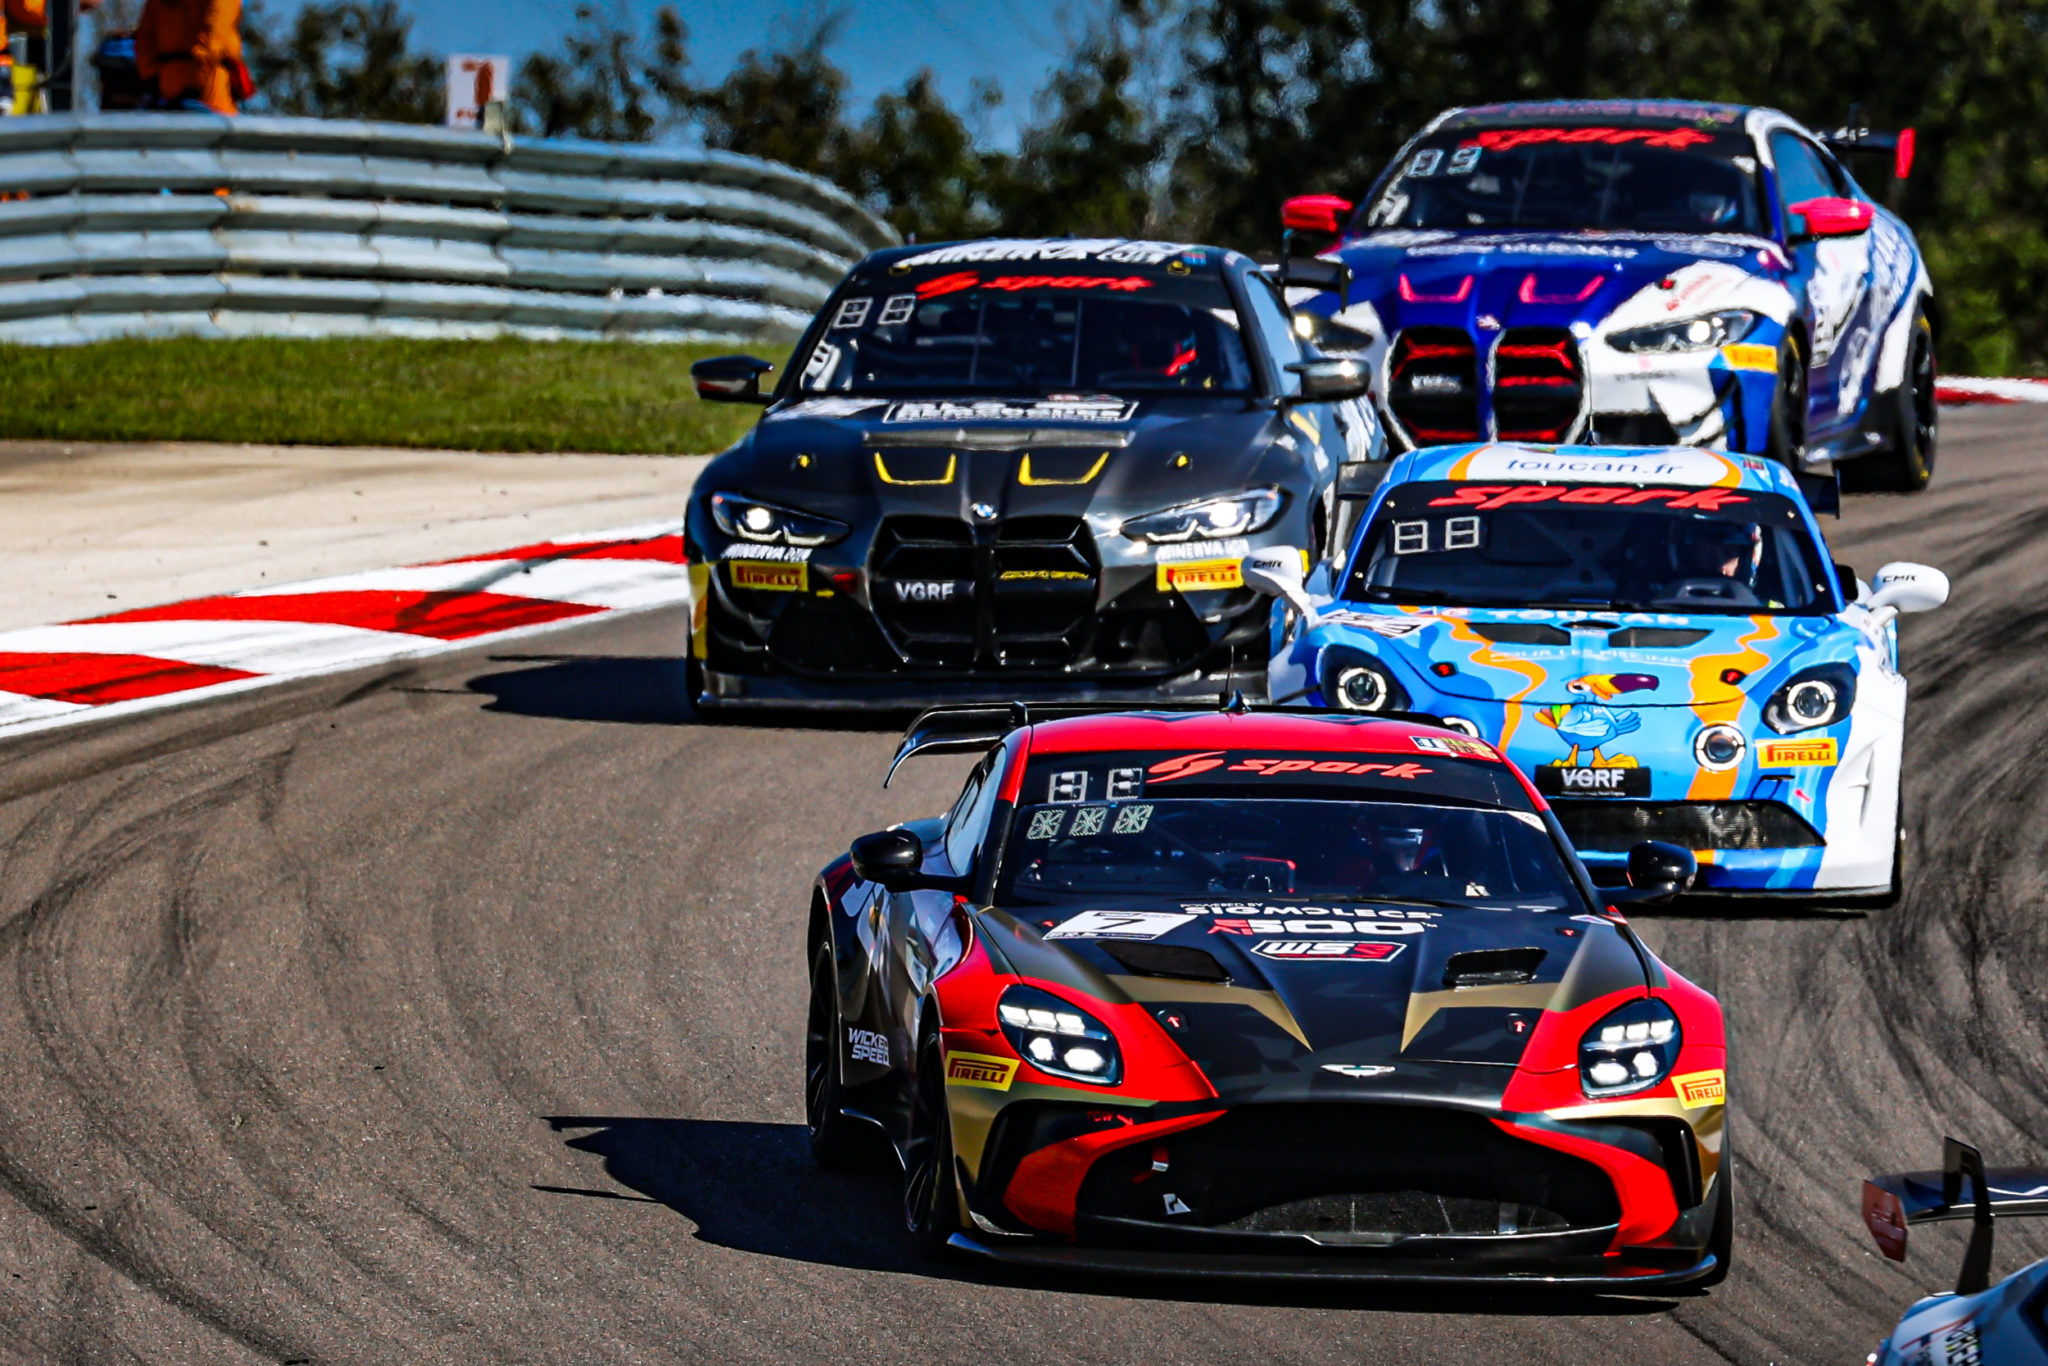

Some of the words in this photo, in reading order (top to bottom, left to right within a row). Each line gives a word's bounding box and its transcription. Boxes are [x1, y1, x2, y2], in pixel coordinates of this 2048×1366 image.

[1507, 459, 1684, 475] toucan.fr
[1428, 485, 1752, 511] spark
[736, 565, 802, 586] PIRELLI
[1166, 565, 1238, 584] PIRELLI
[895, 581, 955, 600] VGRF
[1487, 609, 1689, 625] TOUCAN
[1766, 743, 1831, 763] PIRELLI
[1227, 758, 1434, 780] spark
[1561, 768, 1625, 788] VGRF
[1092, 917, 1147, 930] 7
[848, 1027, 889, 1050] WICKED
[851, 1044, 891, 1067] SPEED
[948, 1058, 1010, 1084] PIRELLI
[1681, 1077, 1723, 1102] PIRELLI
[1087, 1110, 1114, 1121] TOW
